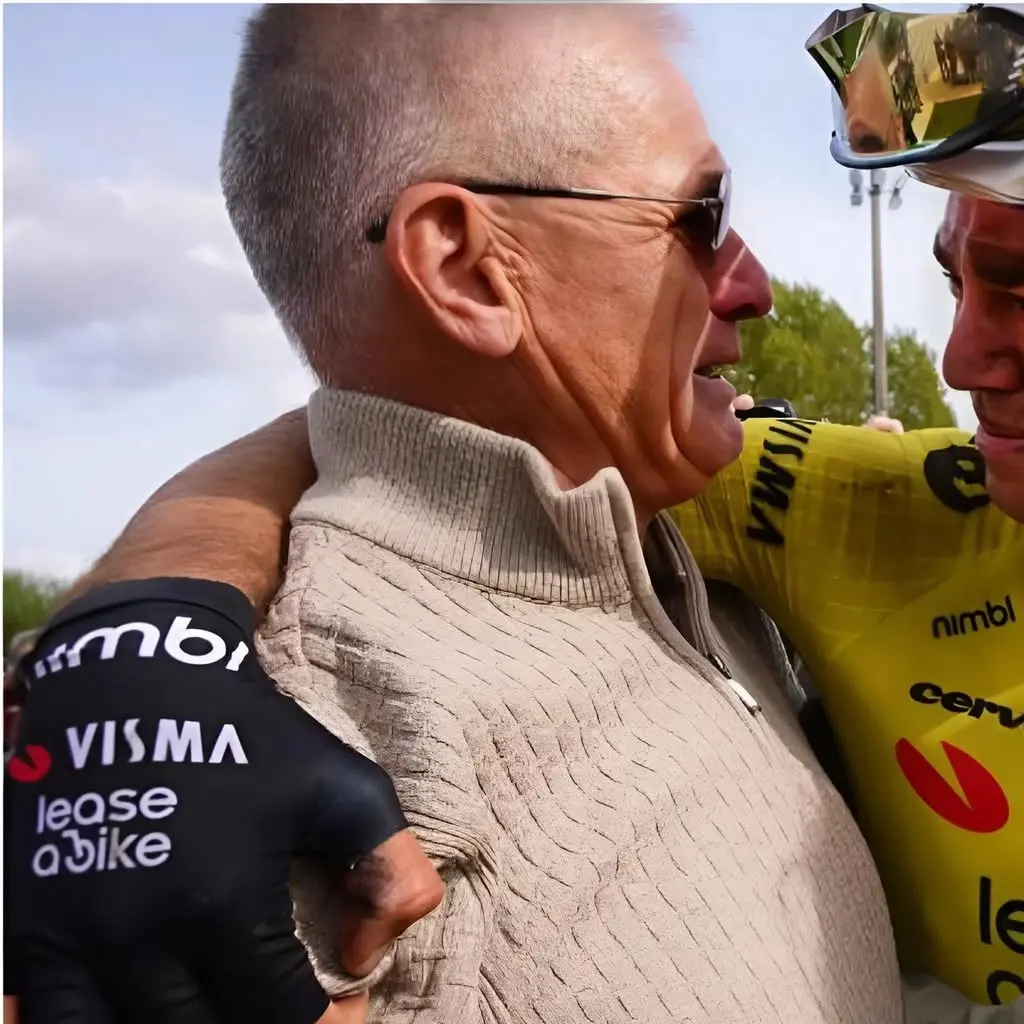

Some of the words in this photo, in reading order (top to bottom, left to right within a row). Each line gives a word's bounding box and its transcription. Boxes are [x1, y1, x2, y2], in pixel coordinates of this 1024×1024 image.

[932, 596, 1016, 639] nimbl
[67, 718, 248, 769] VISMA
[36, 787, 177, 833] lease
